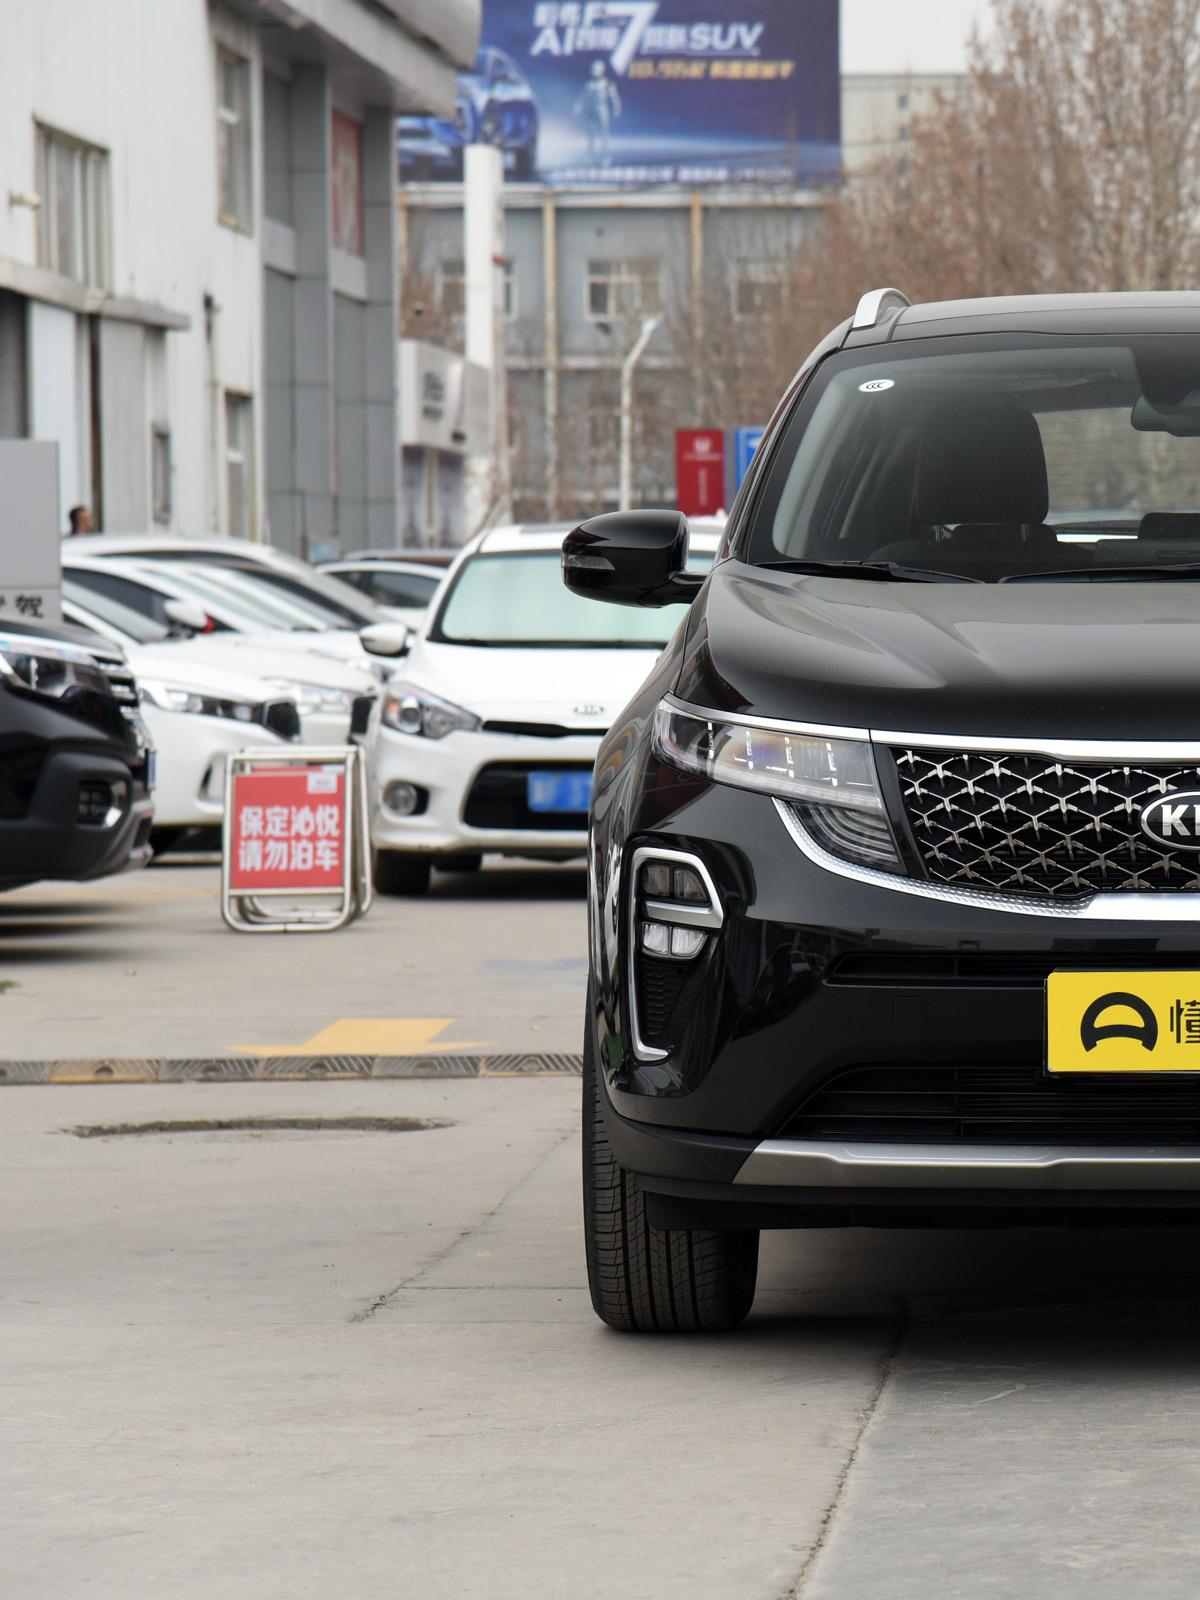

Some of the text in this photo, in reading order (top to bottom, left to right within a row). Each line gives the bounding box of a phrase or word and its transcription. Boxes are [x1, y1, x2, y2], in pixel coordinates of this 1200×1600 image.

[240, 804, 340, 837] 保定沁悦
[239, 838, 340, 872] 请勿泊车
